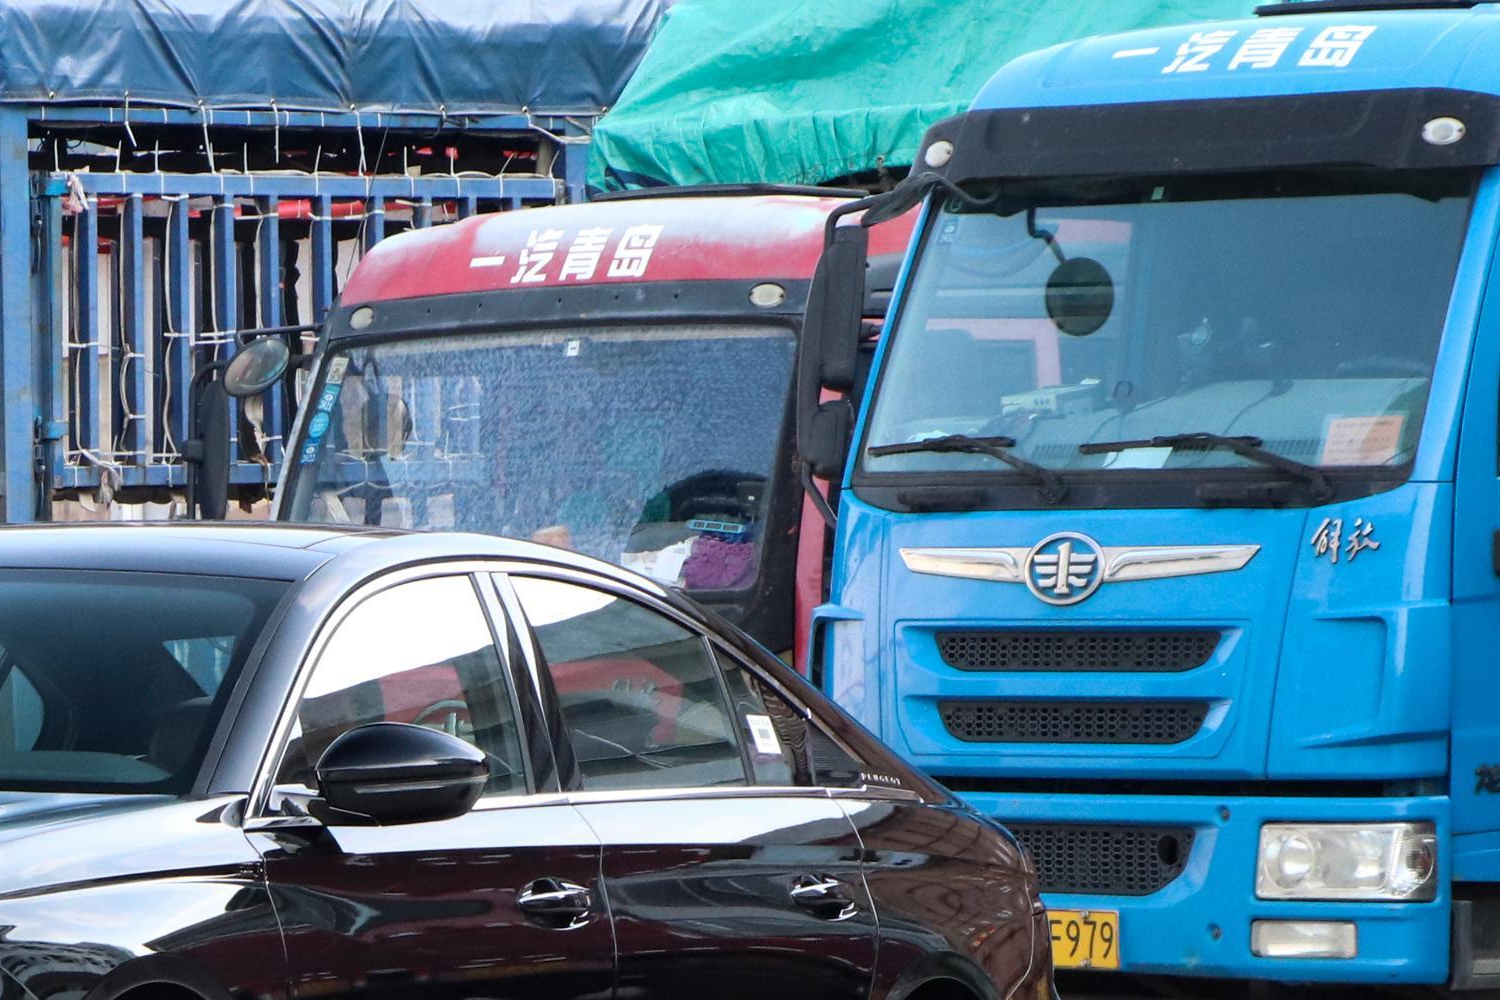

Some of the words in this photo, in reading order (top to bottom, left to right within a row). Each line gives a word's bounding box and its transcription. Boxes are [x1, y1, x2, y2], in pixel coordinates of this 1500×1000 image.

[1112, 25, 1378, 74] 一汽青岛
[469, 224, 665, 283] 一汽青岛
